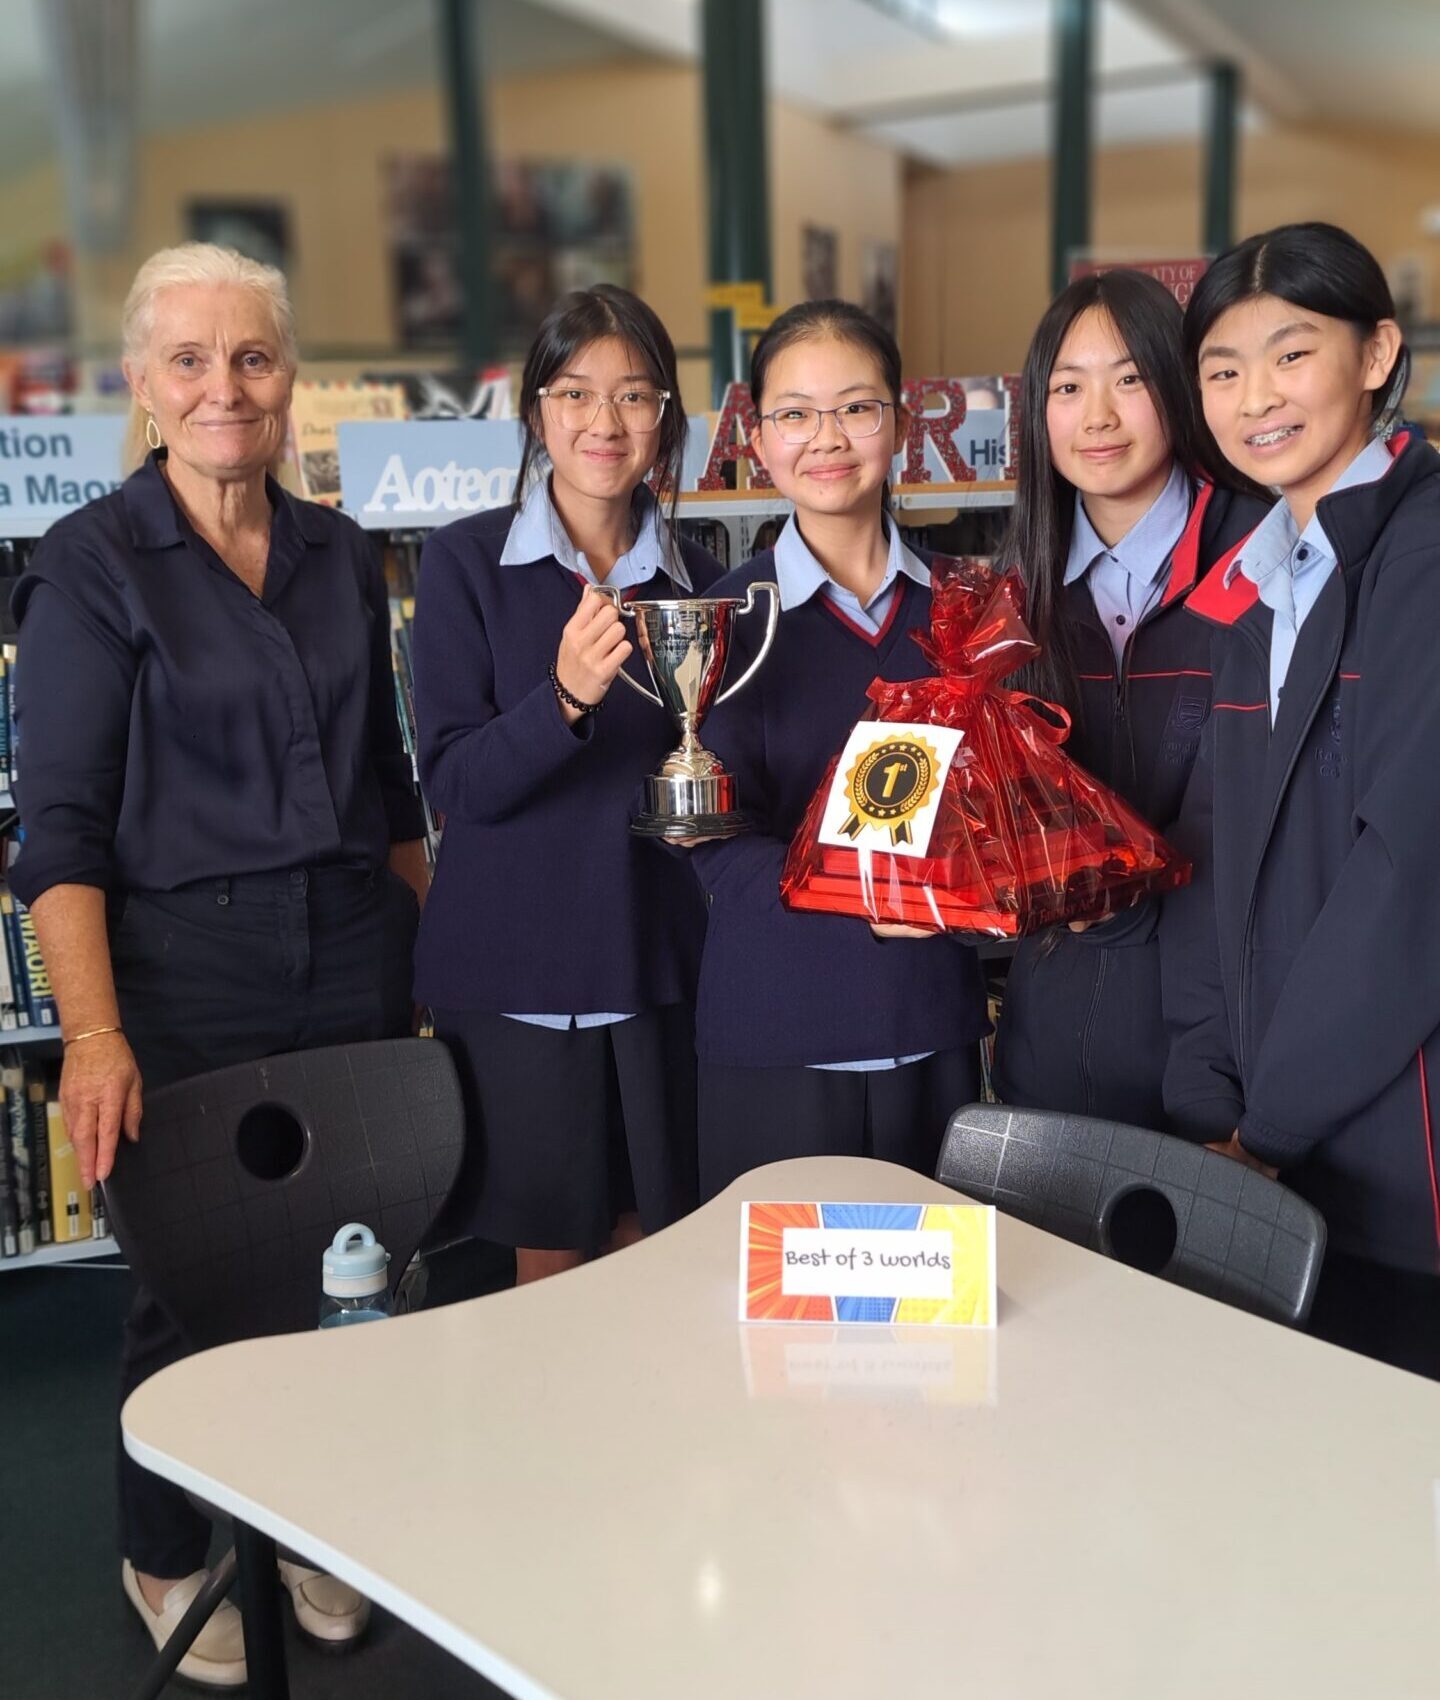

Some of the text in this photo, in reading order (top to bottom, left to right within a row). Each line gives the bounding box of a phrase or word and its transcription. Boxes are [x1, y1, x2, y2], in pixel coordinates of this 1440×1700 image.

[1179, 264, 1199, 280] OF
[882, 762, 908, 798] 1st
[785, 1246, 951, 1271] Best of 3 worlds
